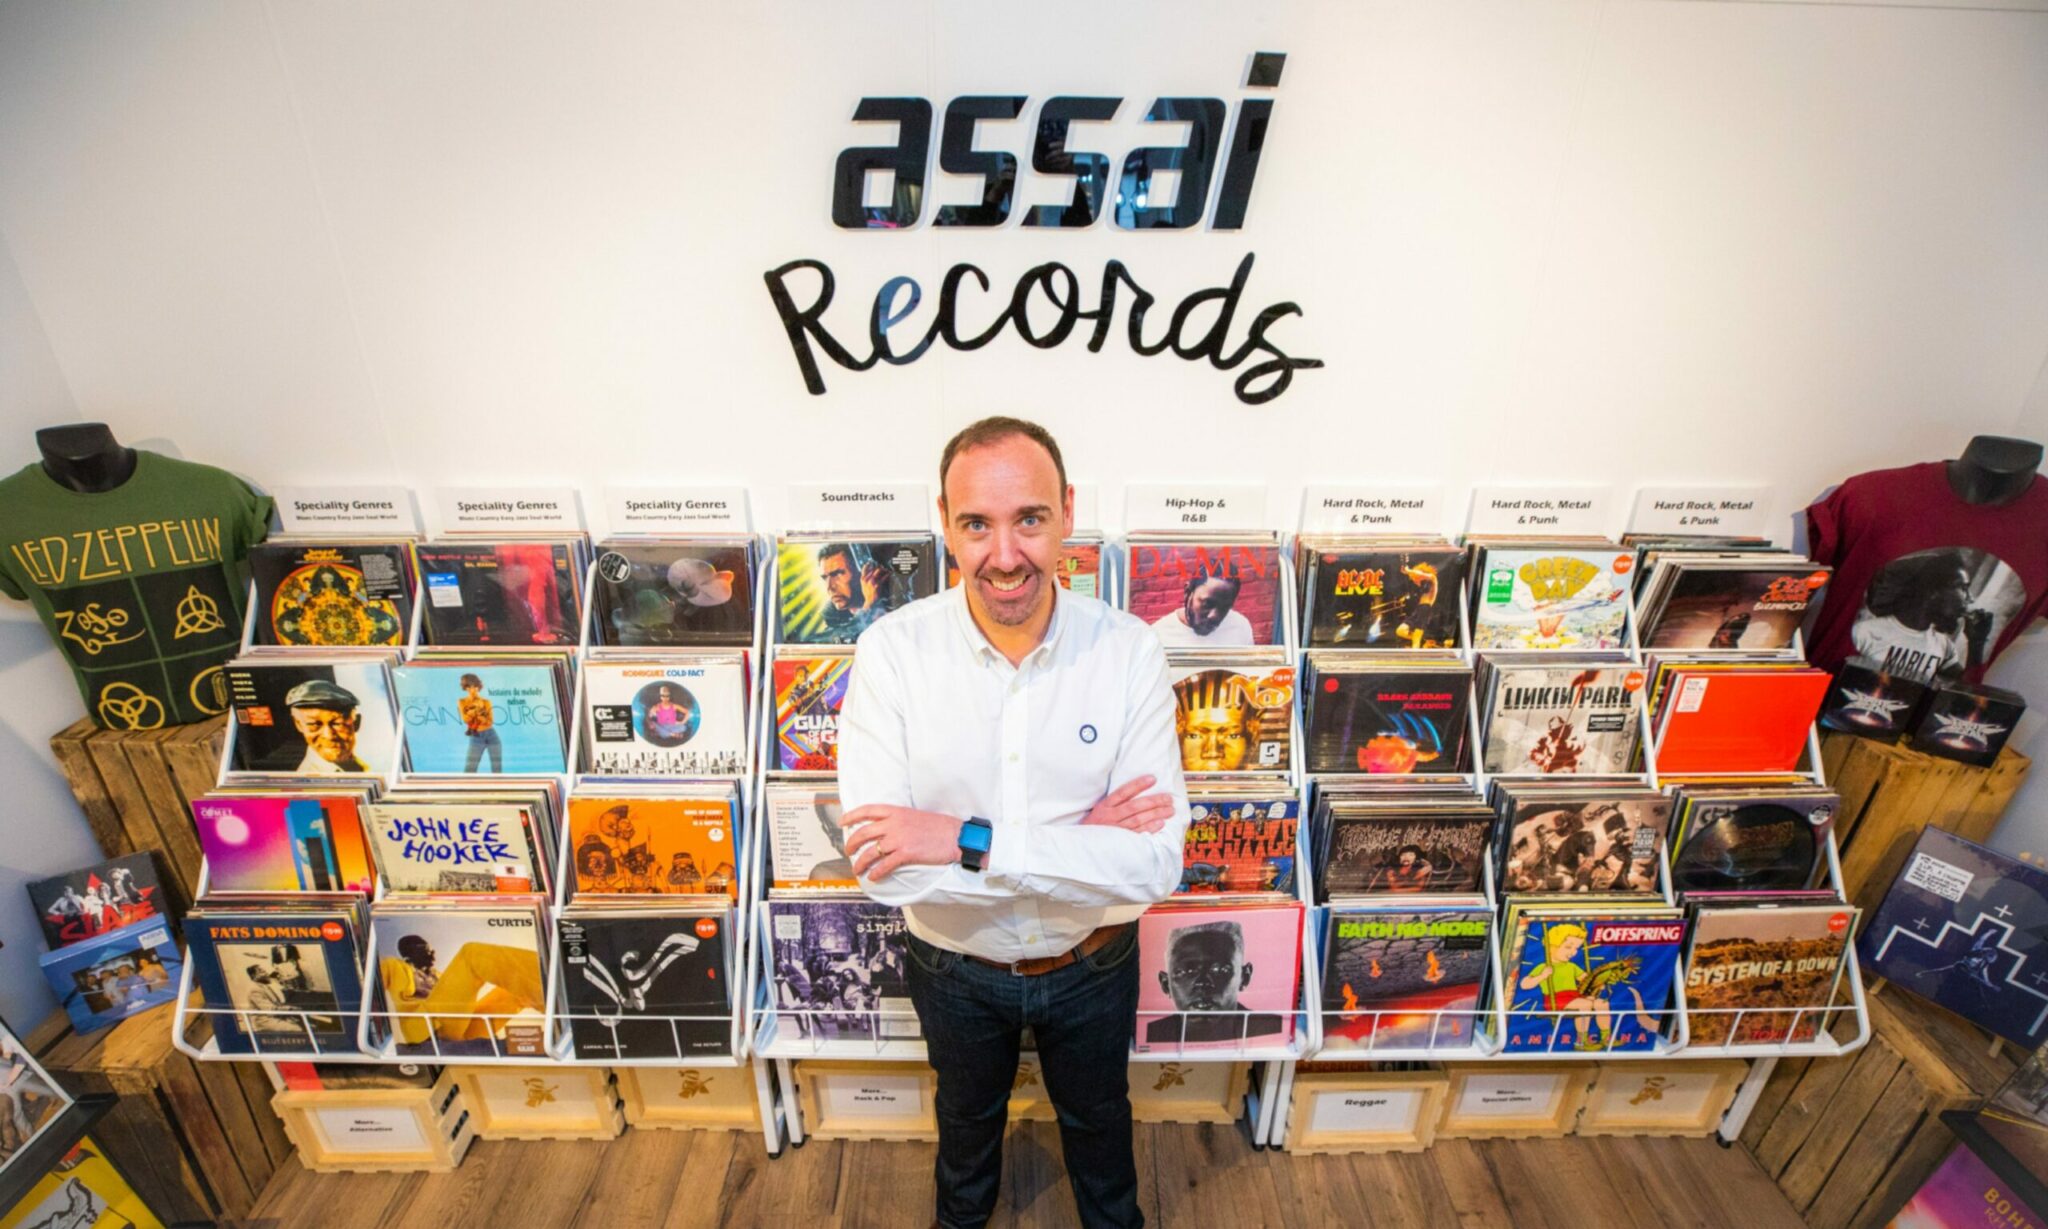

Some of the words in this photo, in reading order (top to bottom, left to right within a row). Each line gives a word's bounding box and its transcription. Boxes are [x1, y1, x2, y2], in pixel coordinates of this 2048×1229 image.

[831, 52, 1287, 230] assai
[764, 252, 1324, 405] Records
[821, 492, 895, 502] Soundtracks
[294, 501, 349, 512] Speciality
[352, 501, 393, 509] Genres
[457, 501, 513, 512] Speciality
[516, 501, 558, 510] Genres
[626, 500, 682, 511] Speciality
[685, 500, 727, 509] Genres
[1165, 498, 1217, 510] Hip-Hop
[1217, 499, 1226, 508] &
[1322, 499, 1352, 508] Hard
[1355, 499, 1386, 510] Rock,
[1390, 499, 1424, 509] Metal
[1491, 500, 1521, 509] Hard
[1523, 500, 1555, 511] Rock,
[1558, 500, 1591, 509] Metal
[1654, 501, 1684, 510] Hard
[1686, 501, 1717, 512] Rock,
[1720, 501, 1753, 510] Metal
[1181, 514, 1207, 523] R&B
[1350, 514, 1359, 523] &
[1362, 514, 1392, 523] Punk
[1517, 515, 1526, 524] &
[1529, 515, 1559, 524] Punk
[1679, 516, 1688, 525] &
[1690, 516, 1719, 525] Punk
[11, 536, 68, 585] LED
[72, 517, 224, 581] ZEPPELIN
[1131, 545, 1279, 579] DAMN.
[1519, 556, 1601, 586] GREEN
[1335, 583, 1384, 596] LIVE
[1530, 577, 1588, 603] DAY
[1503, 687, 1576, 710] LINKIN
[1578, 687, 1633, 709] PARK
[404, 704, 554, 726] GAINOURG
[794, 715, 839, 730] GUA
[387, 817, 451, 842] JOHN
[458, 818, 500, 843] LEE
[402, 839, 520, 865] HOOKER
[487, 918, 534, 927] CURTIS
[209, 927, 251, 938] FATS
[253, 927, 321, 939] DOMINO
[1338, 922, 1394, 938] FAITH
[1397, 921, 1428, 938] NO
[1429, 921, 1487, 937] MORE
[1602, 926, 1681, 943] OFFSPRING
[1688, 961, 1760, 988] SYSTEM
[1761, 960, 1783, 977] OF
[1782, 959, 1794, 974] A
[1797, 955, 1839, 974] DOWN
[1511, 1032, 1648, 1046] AMRICNA
[1345, 1099, 1387, 1107] Reggae
